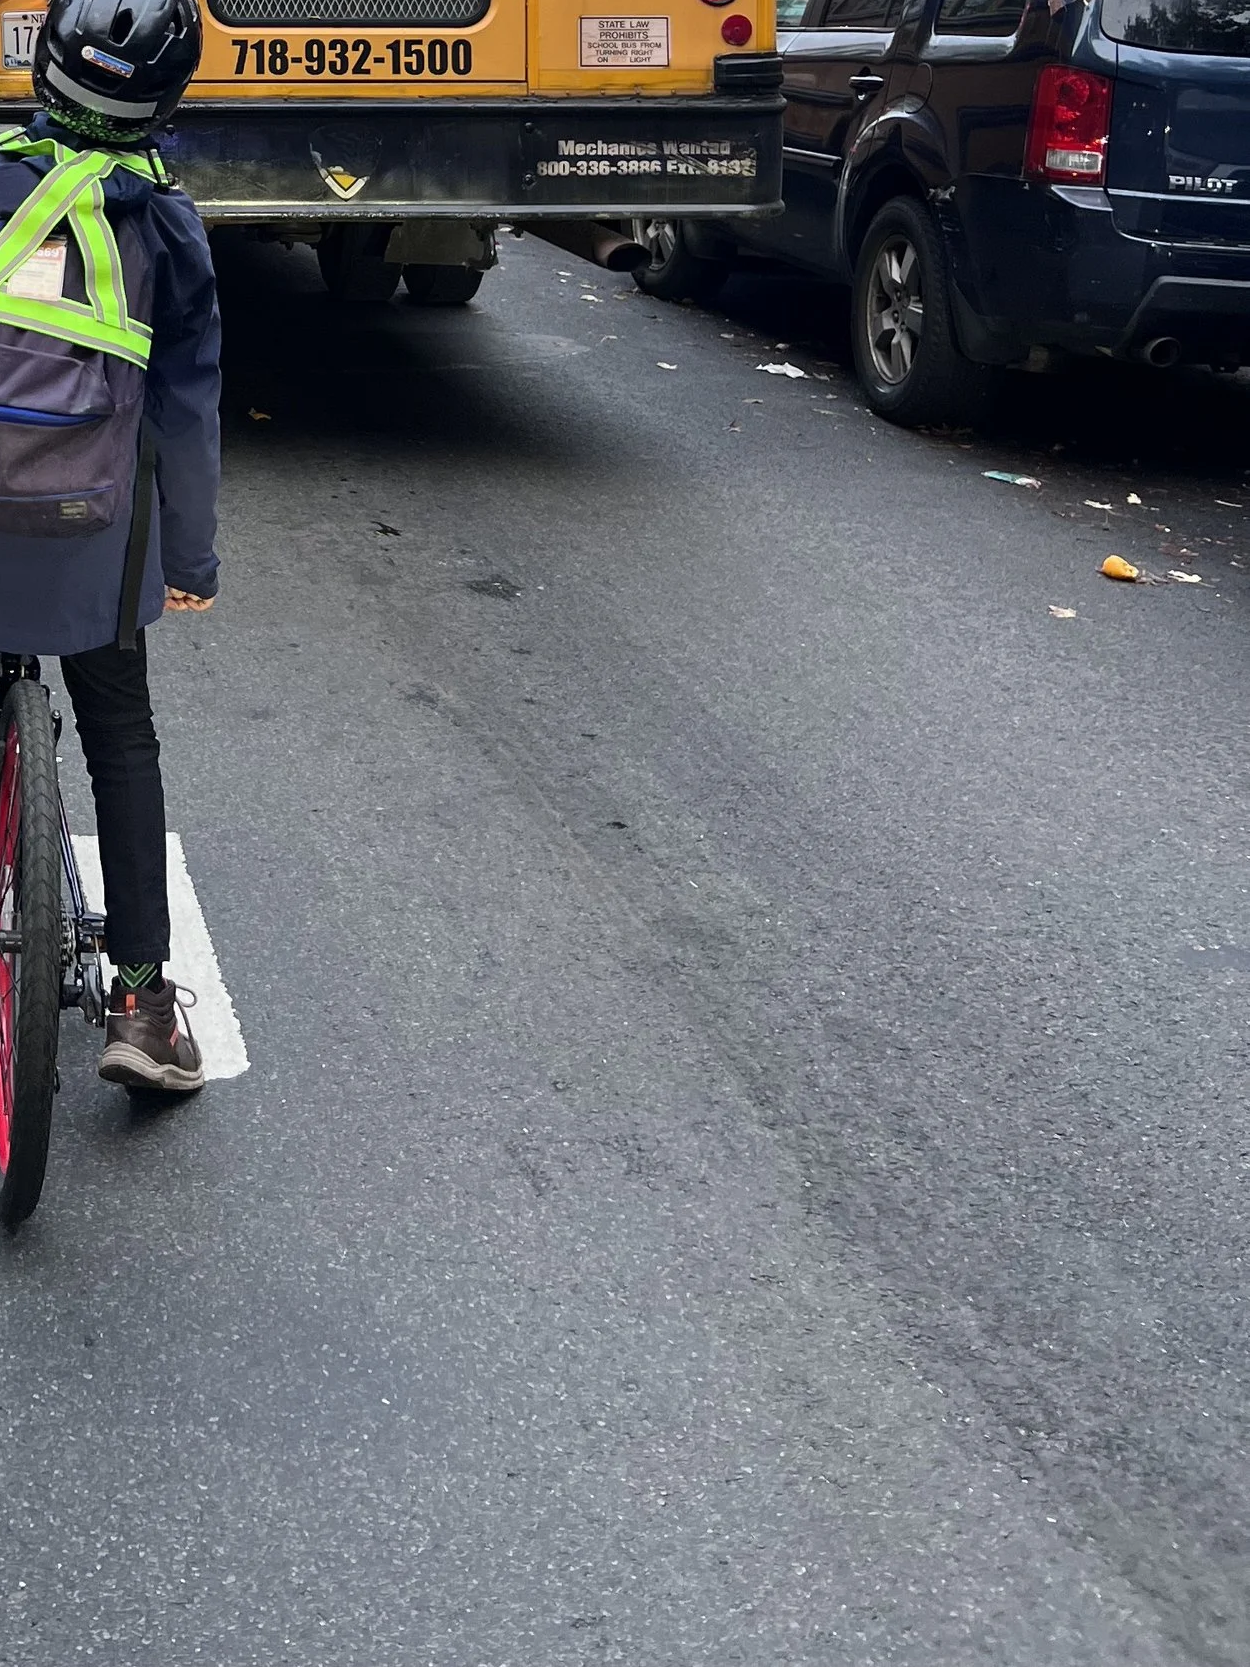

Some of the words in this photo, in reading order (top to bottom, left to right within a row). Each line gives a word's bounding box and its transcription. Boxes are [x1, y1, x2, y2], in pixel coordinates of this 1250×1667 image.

[31, 14, 46, 24] NE
[598, 20, 625, 29] STATE
[629, 20, 650, 29] LAW
[12, 26, 41, 55] 17
[599, 31, 649, 40] PROHIBITS
[231, 38, 472, 76] 718-932-1500
[557, 139, 657, 156] Mechanics
[662, 139, 731, 155] Wanted
[536, 160, 662, 176] 800-336-3886
[1168, 175, 1238, 194] PILOT
